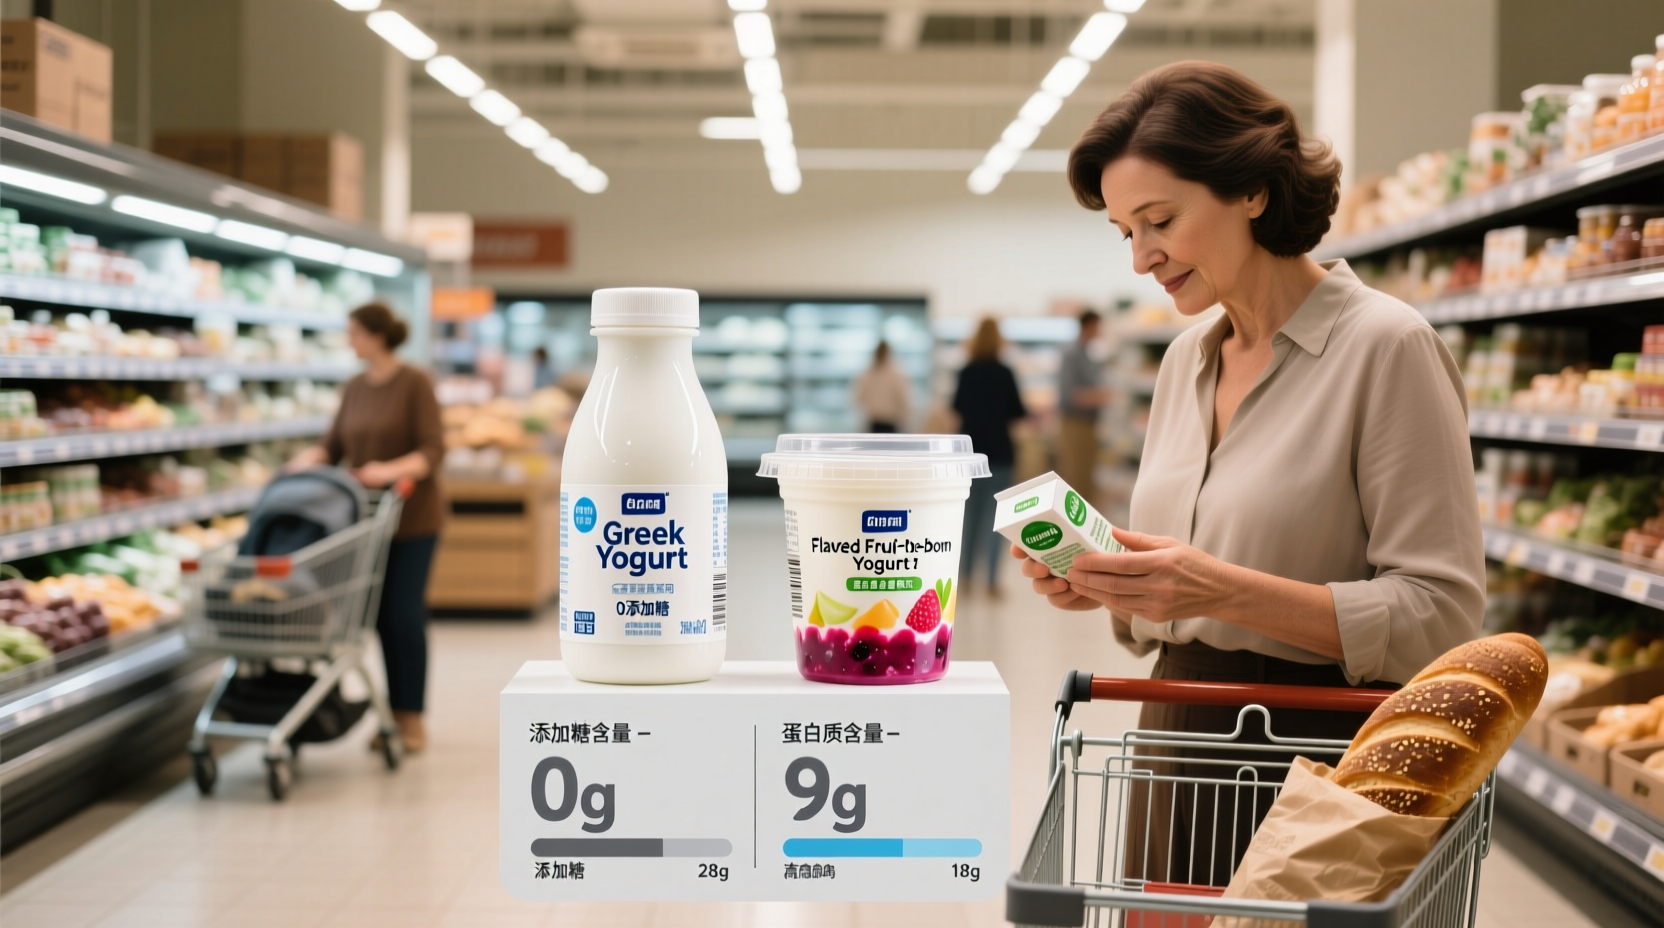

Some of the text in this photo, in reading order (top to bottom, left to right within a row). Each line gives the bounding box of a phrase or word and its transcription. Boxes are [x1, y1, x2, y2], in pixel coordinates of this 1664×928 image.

[603, 519, 686, 545] Greek
[811, 536, 861, 554] Flaved
[596, 545, 689, 577] Yogurt
[852, 556, 910, 575] Yogurt
[529, 722, 632, 744] 添加糖含量
[781, 722, 884, 744] 蛋白质含量
[530, 755, 616, 834] 0g
[784, 755, 867, 834] 9g
[534, 860, 586, 881] 添加糖
[697, 863, 730, 883] 28g
[951, 863, 981, 883] 18g
